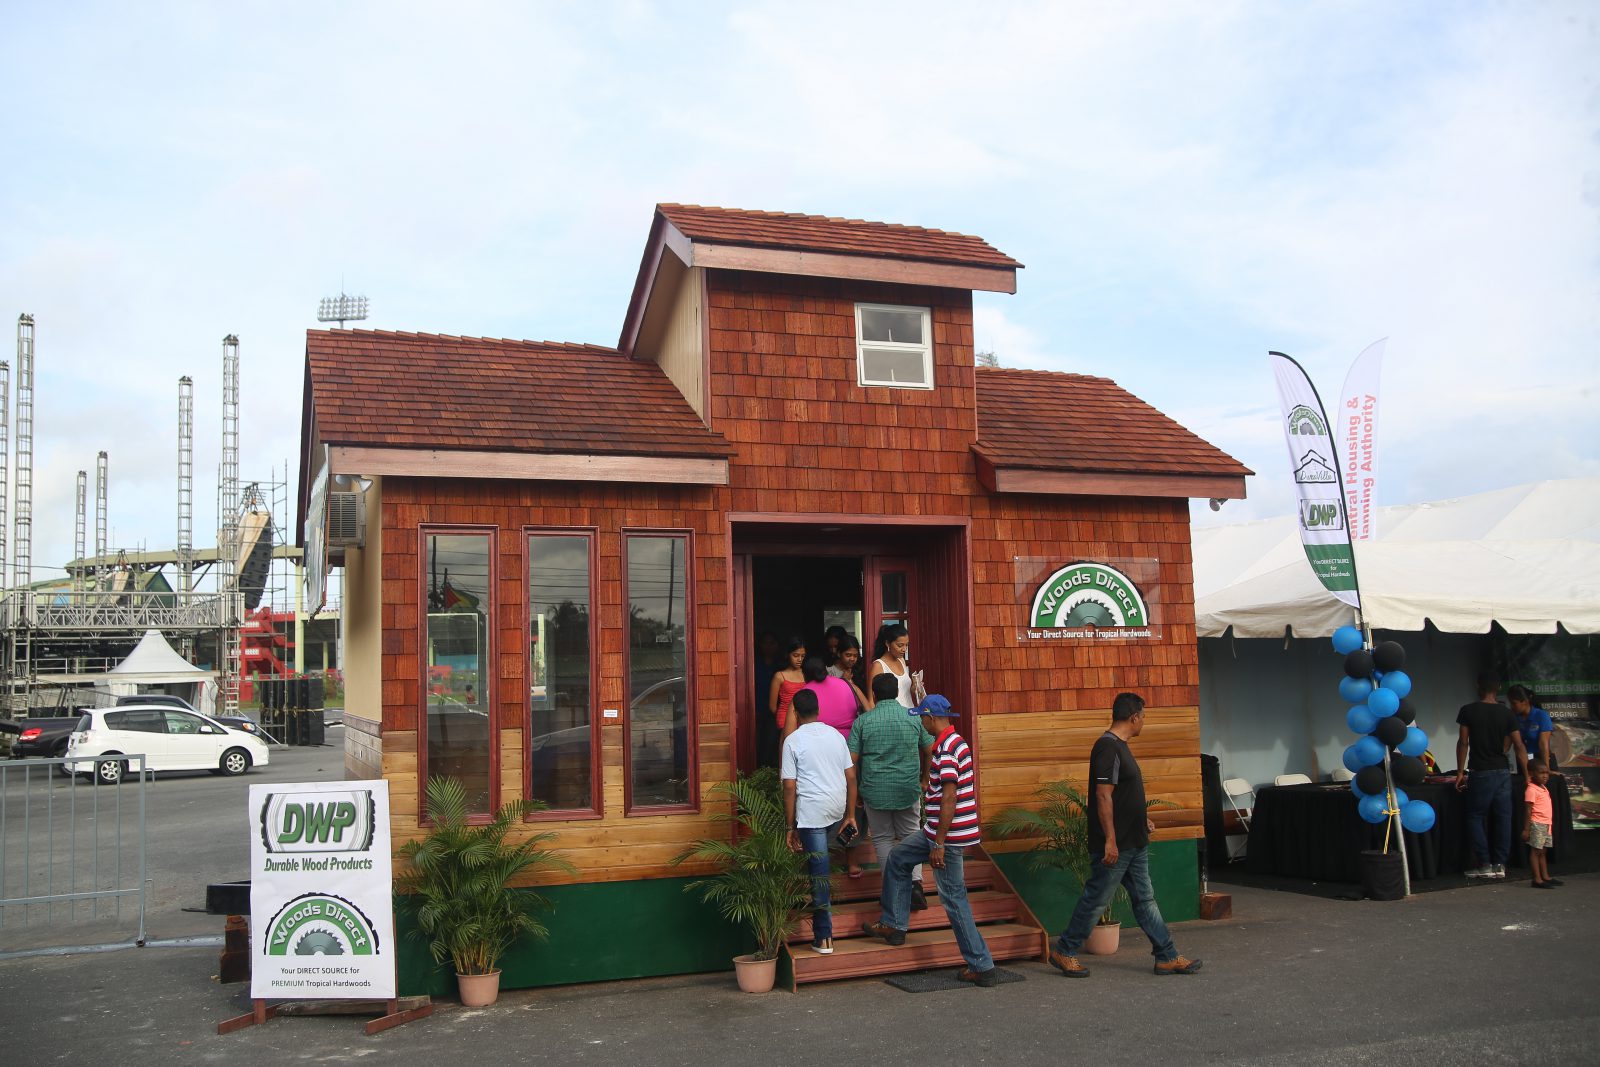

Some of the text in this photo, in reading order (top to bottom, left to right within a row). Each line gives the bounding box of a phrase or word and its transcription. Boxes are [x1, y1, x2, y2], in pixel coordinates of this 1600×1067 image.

[1346, 396, 1361, 540] entral Housing &
[1360, 394, 1377, 540] lanning Authority
[1307, 504, 1337, 526] DWP
[1040, 570, 1138, 618] Woods Direct
[1027, 628, 1152, 639] Your Direct Source for Tropical Hardwoods
[1535, 684, 1564, 693] DIRECT
[1566, 683, 1600, 692] SOURC
[277, 801, 357, 844] DWP
[264, 856, 373, 872] Durable Wood Products
[273, 902, 368, 948] Woods Direct
[280, 966, 360, 975] Your DIRECT SOURCE for
[271, 979, 371, 988] PREMIUM Tropical Hardwoods
